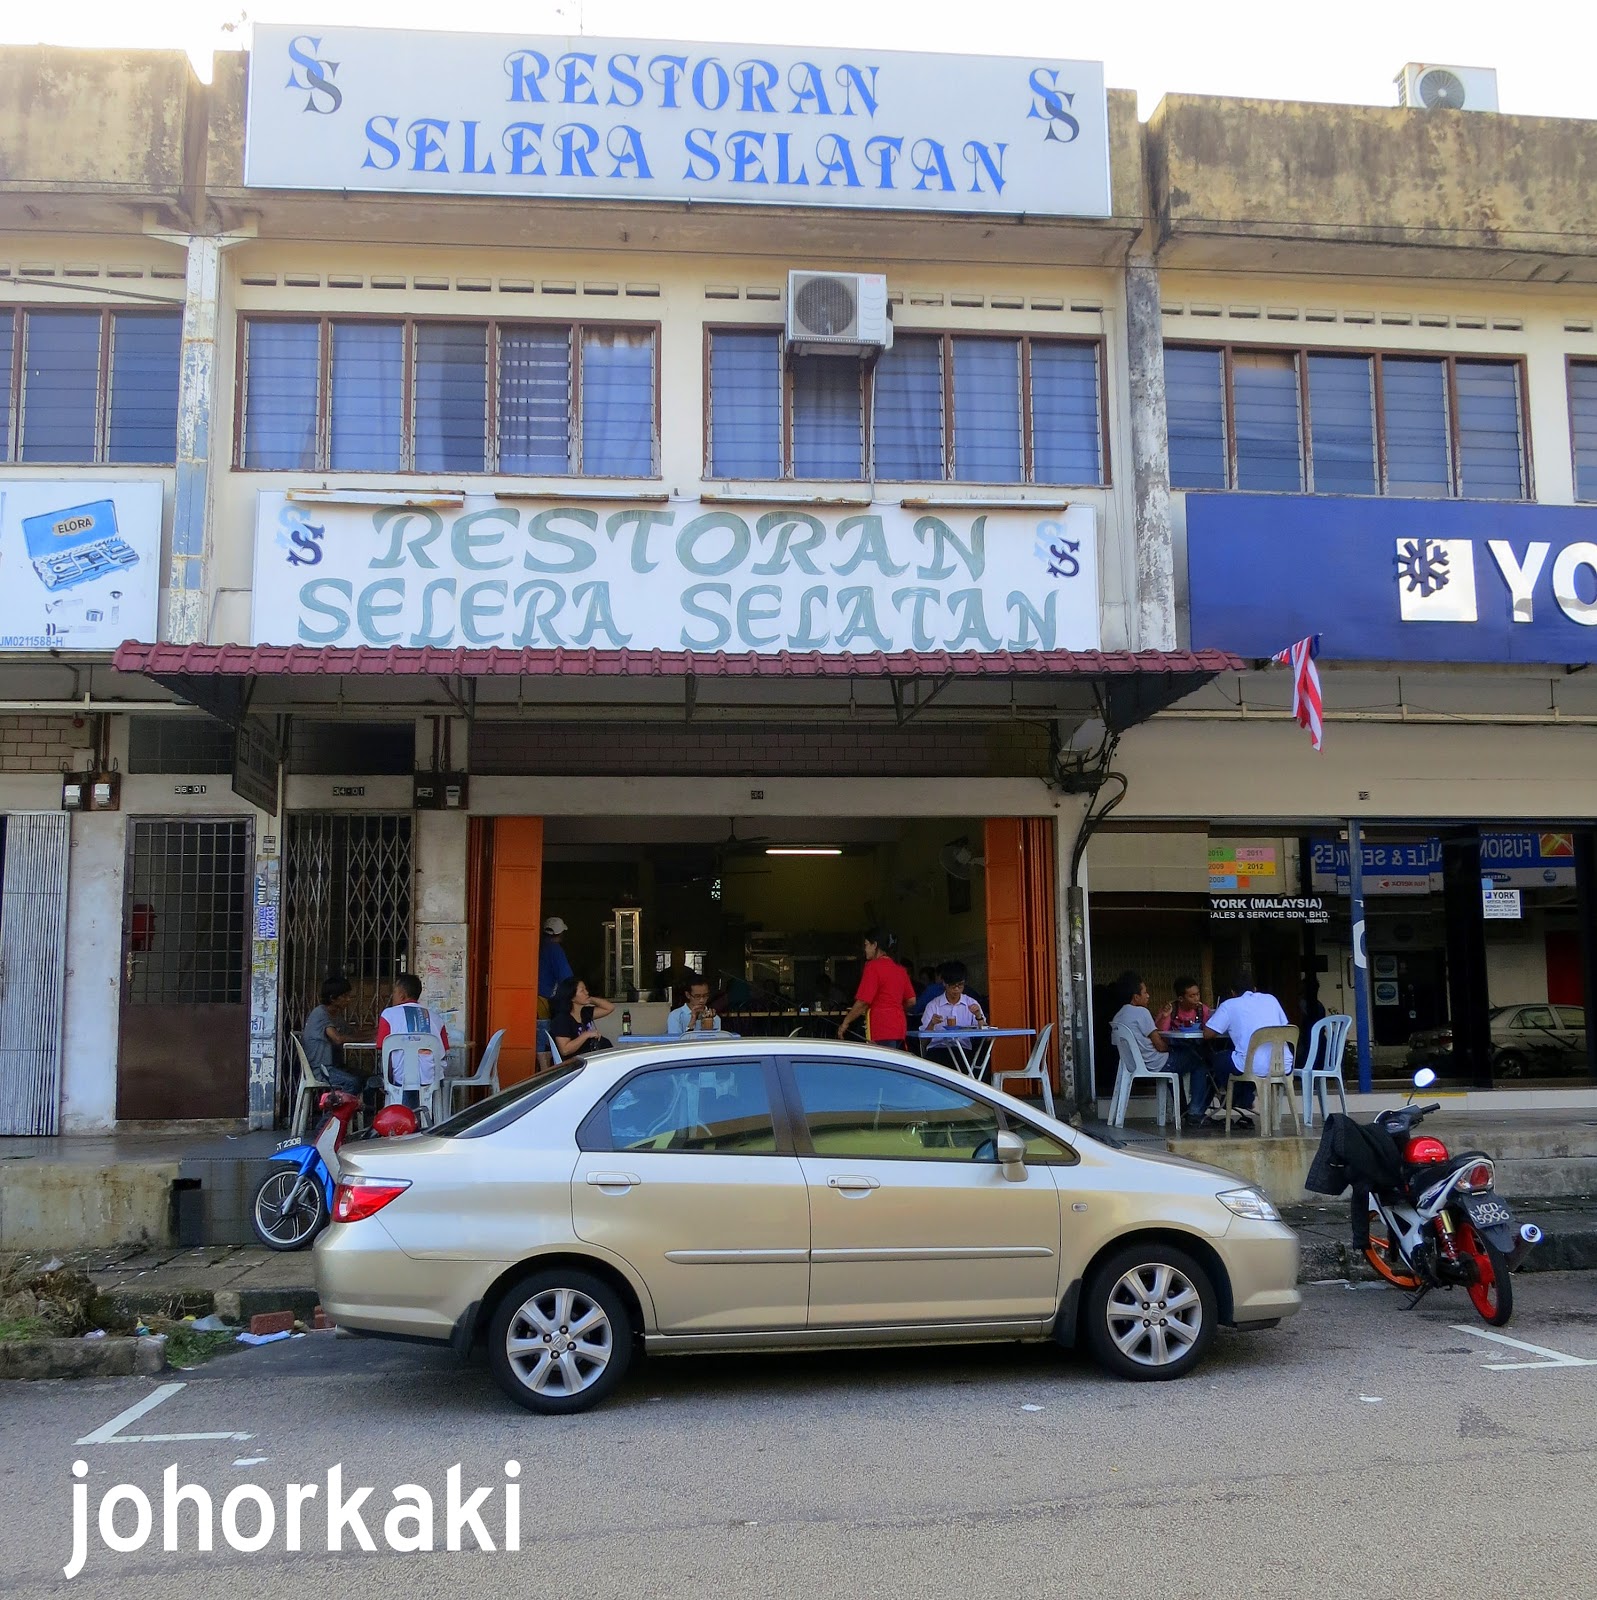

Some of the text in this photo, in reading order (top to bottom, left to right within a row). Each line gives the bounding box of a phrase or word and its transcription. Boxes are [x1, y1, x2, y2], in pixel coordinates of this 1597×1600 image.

[502, 49, 881, 121] RESTORAN
[361, 115, 1010, 196] SELERA SELATAN
[57, 518, 93, 535] ELORA
[367, 505, 987, 580] RESTORAN
[297, 575, 1060, 652] SELERA SELATAN
[333, 786, 365, 796] 34-01
[1493, 891, 1515, 899] YORK
[1211, 898, 1322, 910] YORK (MALAYSIA)
[1210, 911, 1331, 919] ALES & SERVICE SDN. BHD.
[283, 1137, 302, 1148] 2308
[1476, 1202, 1499, 1215] KCD
[1476, 1210, 1510, 1224] 5996
